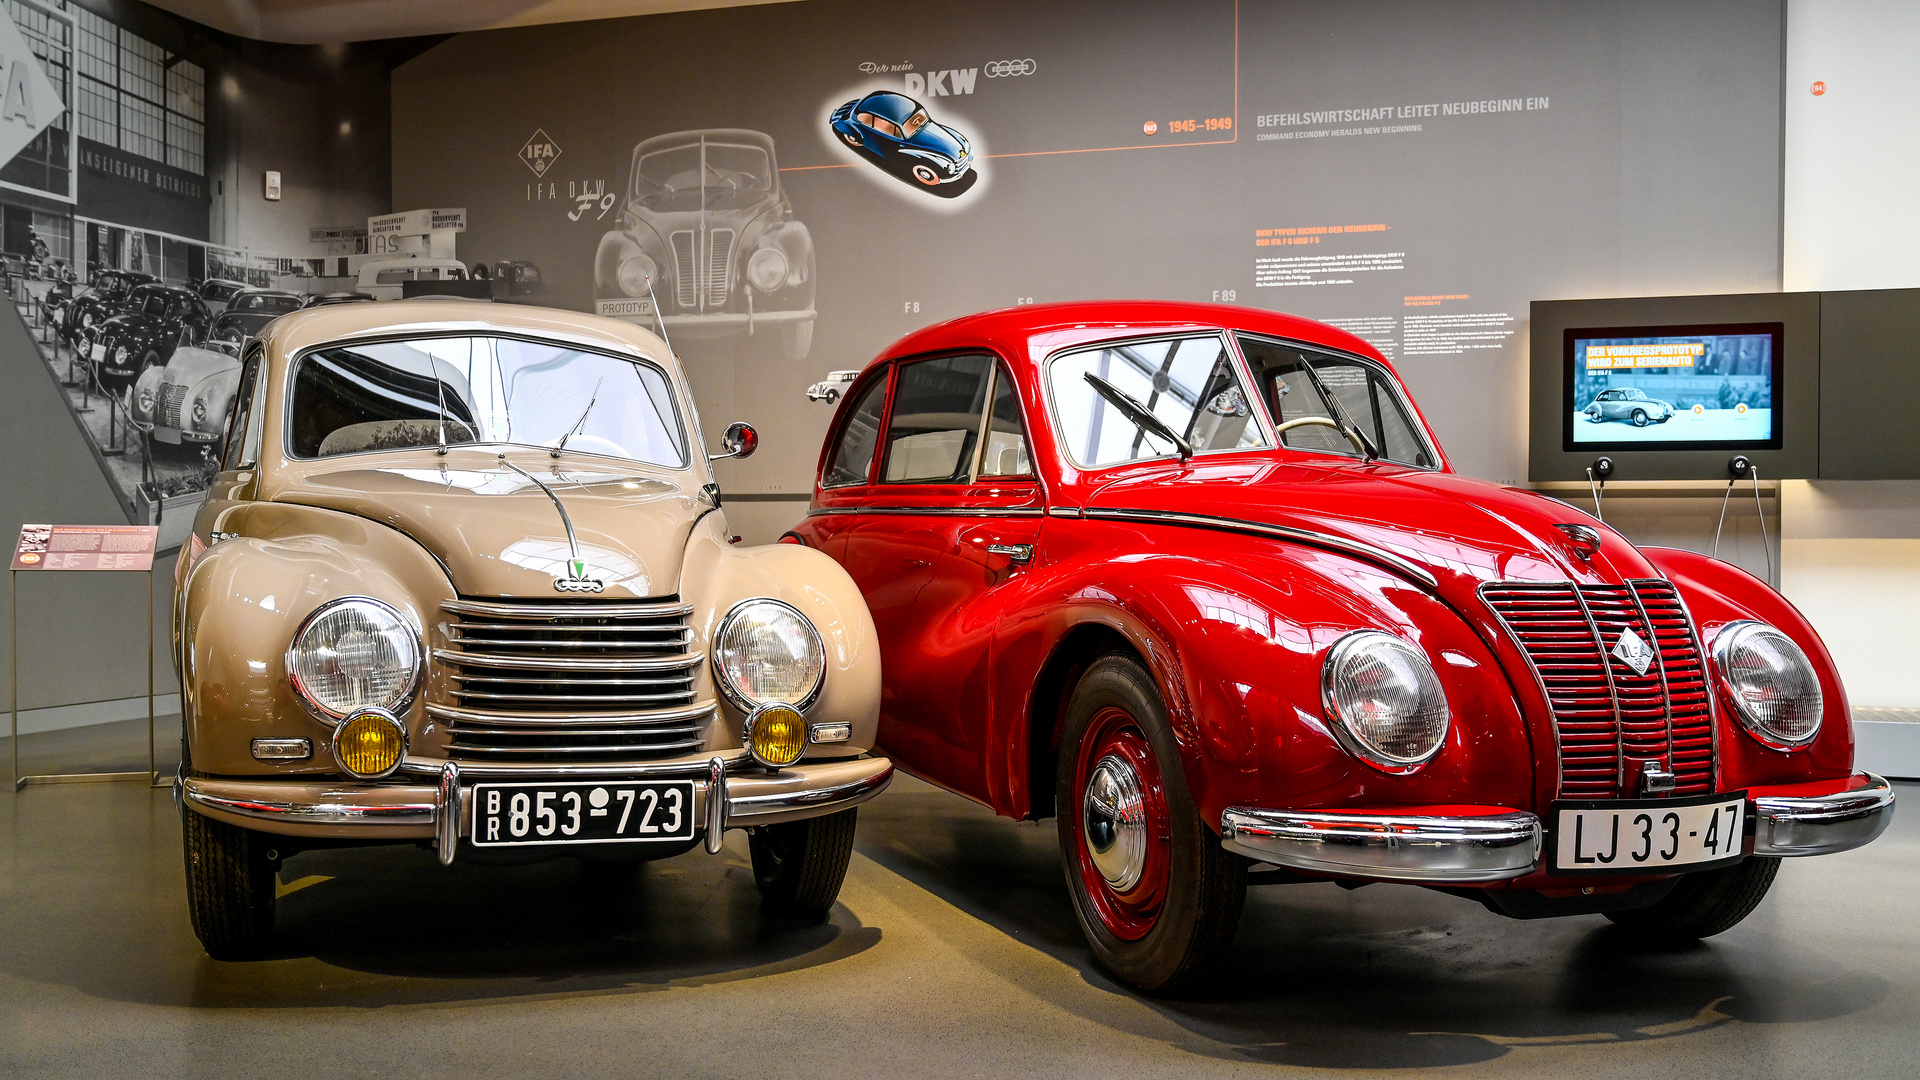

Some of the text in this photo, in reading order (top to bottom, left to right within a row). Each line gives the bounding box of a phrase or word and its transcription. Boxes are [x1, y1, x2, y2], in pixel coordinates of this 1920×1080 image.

[858, 61, 889, 74] Der
[904, 68, 978, 98] DKW
[1256, 96, 1549, 128] BEFEHLSWIRTSCHAFT LEITET NEUBEGINN EIN
[1256, 124, 1422, 141] COMMAND ECONOMY HERALDS NEW BEGINNING
[527, 143, 554, 159] IFA
[63, 143, 149, 184] VLKSEIGENER
[527, 179, 605, 201] IFA DKW
[1274, 228, 1296, 236] TYPEN
[1344, 224, 1386, 233] NEUBEGINN
[1212, 290, 1236, 302] F 89
[602, 302, 649, 314] PROTOTYP
[905, 302, 920, 313] F 8
[1588, 345, 1703, 357] DER VORKRIEGSPROTOTYP
[1588, 356, 1692, 367] WIRD ZUM SERIENAUTO
[1574, 814, 1619, 864] LJ
